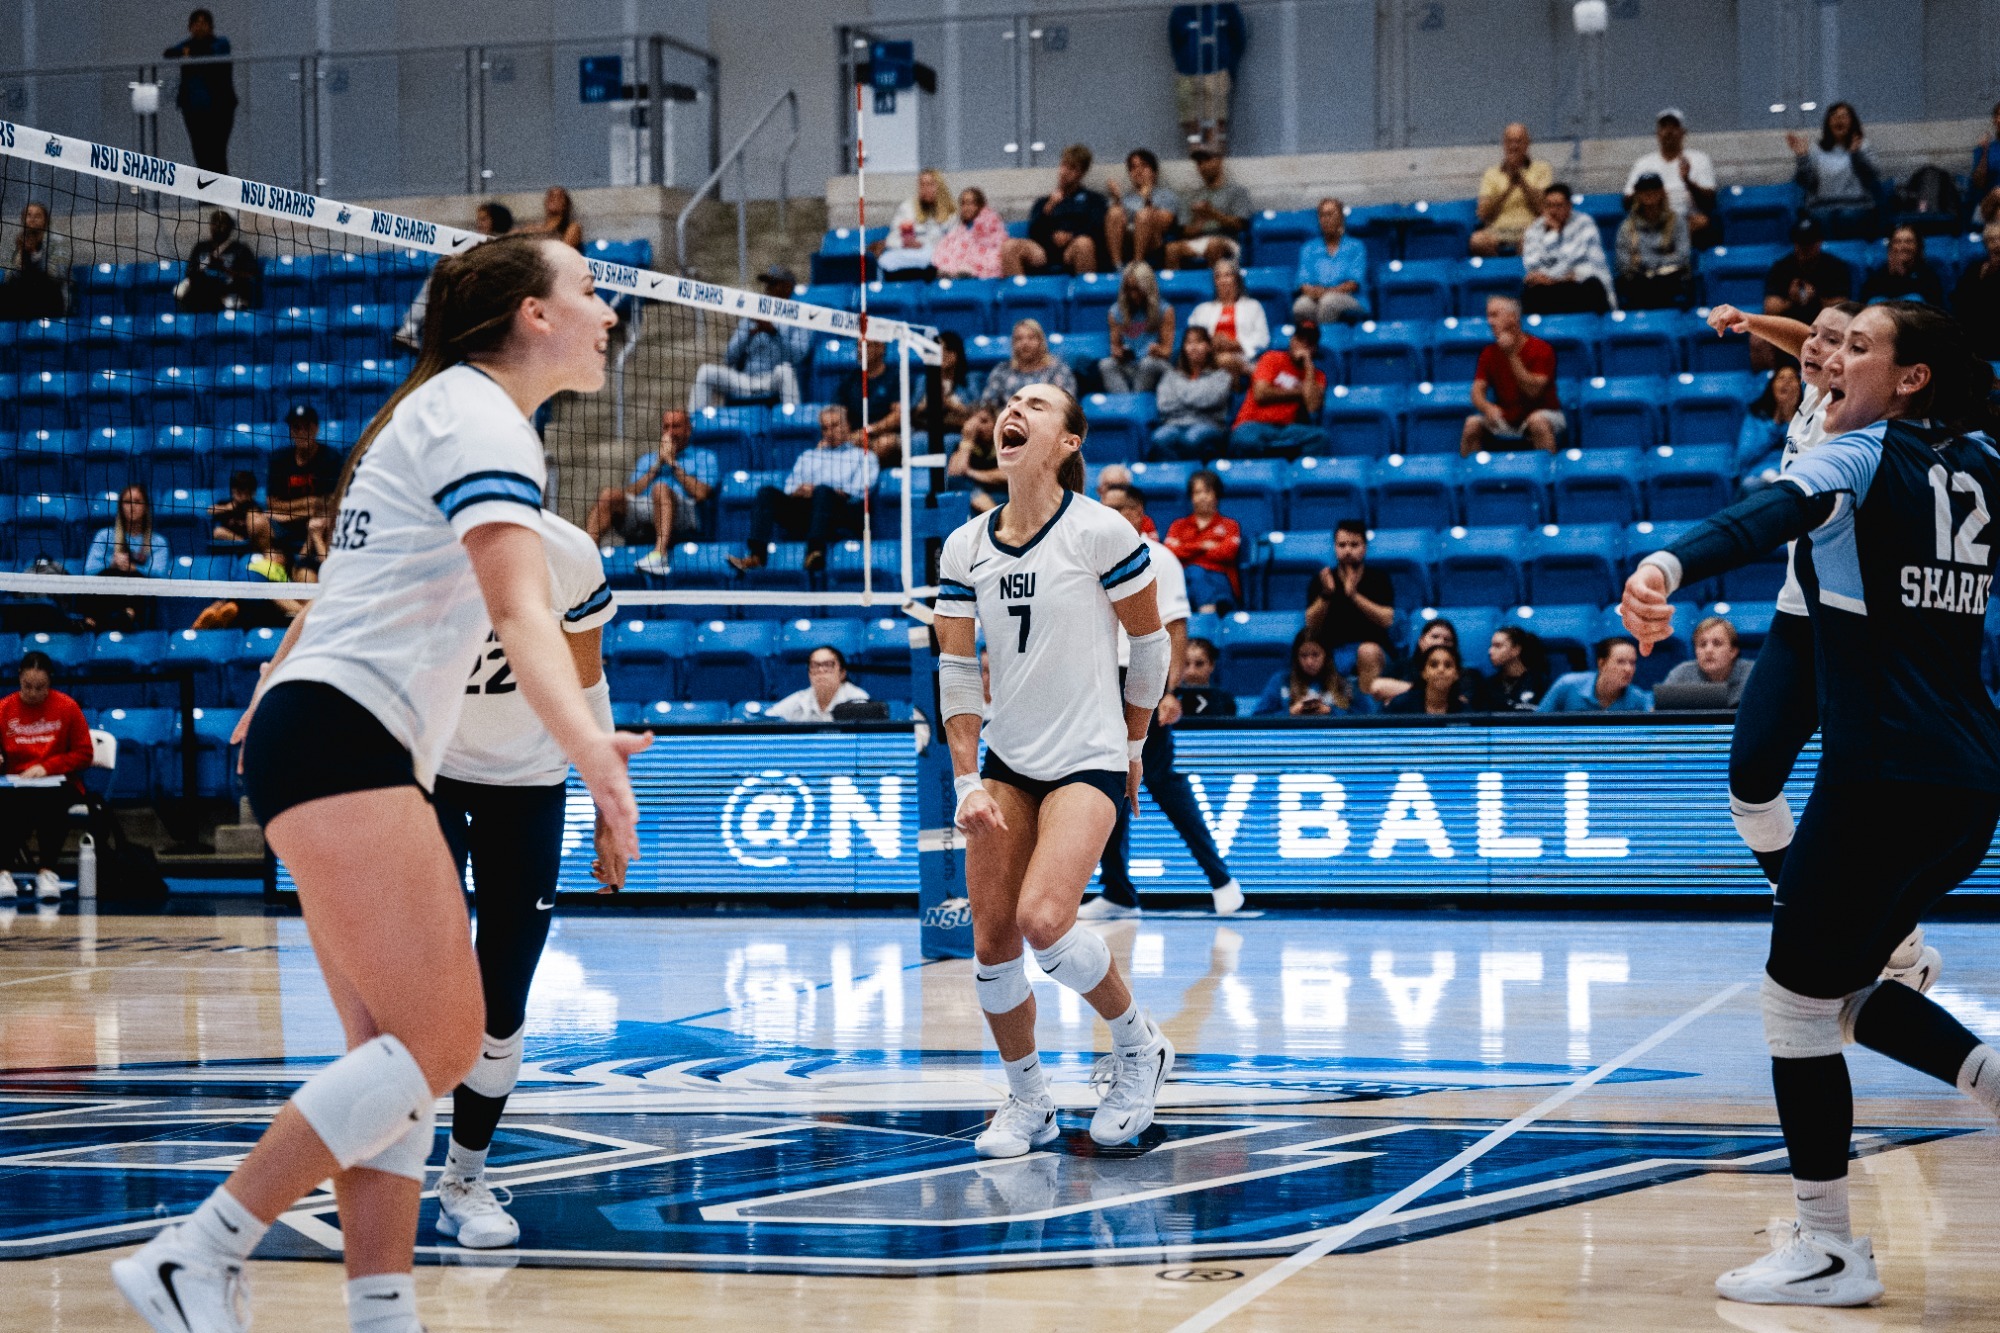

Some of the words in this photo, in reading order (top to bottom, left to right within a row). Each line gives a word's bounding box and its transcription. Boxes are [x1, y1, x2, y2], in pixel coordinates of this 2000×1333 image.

[90, 144, 119, 173] NSU
[122, 151, 176, 187] SHARKS
[241, 180, 266, 207] NSU
[268, 187, 316, 218] SHARKS
[371, 211, 392, 235] NSU
[394, 217, 437, 245] SHARKS
[605, 265, 639, 288] SHARKS
[677, 280, 692, 300] NSU
[694, 283, 724, 306] SHARKS
[1928, 463, 1991, 566] 12
[1000, 572, 1036, 600] NSU
[1007, 604, 1032, 654] 7
[922, 906, 973, 930] NSU
